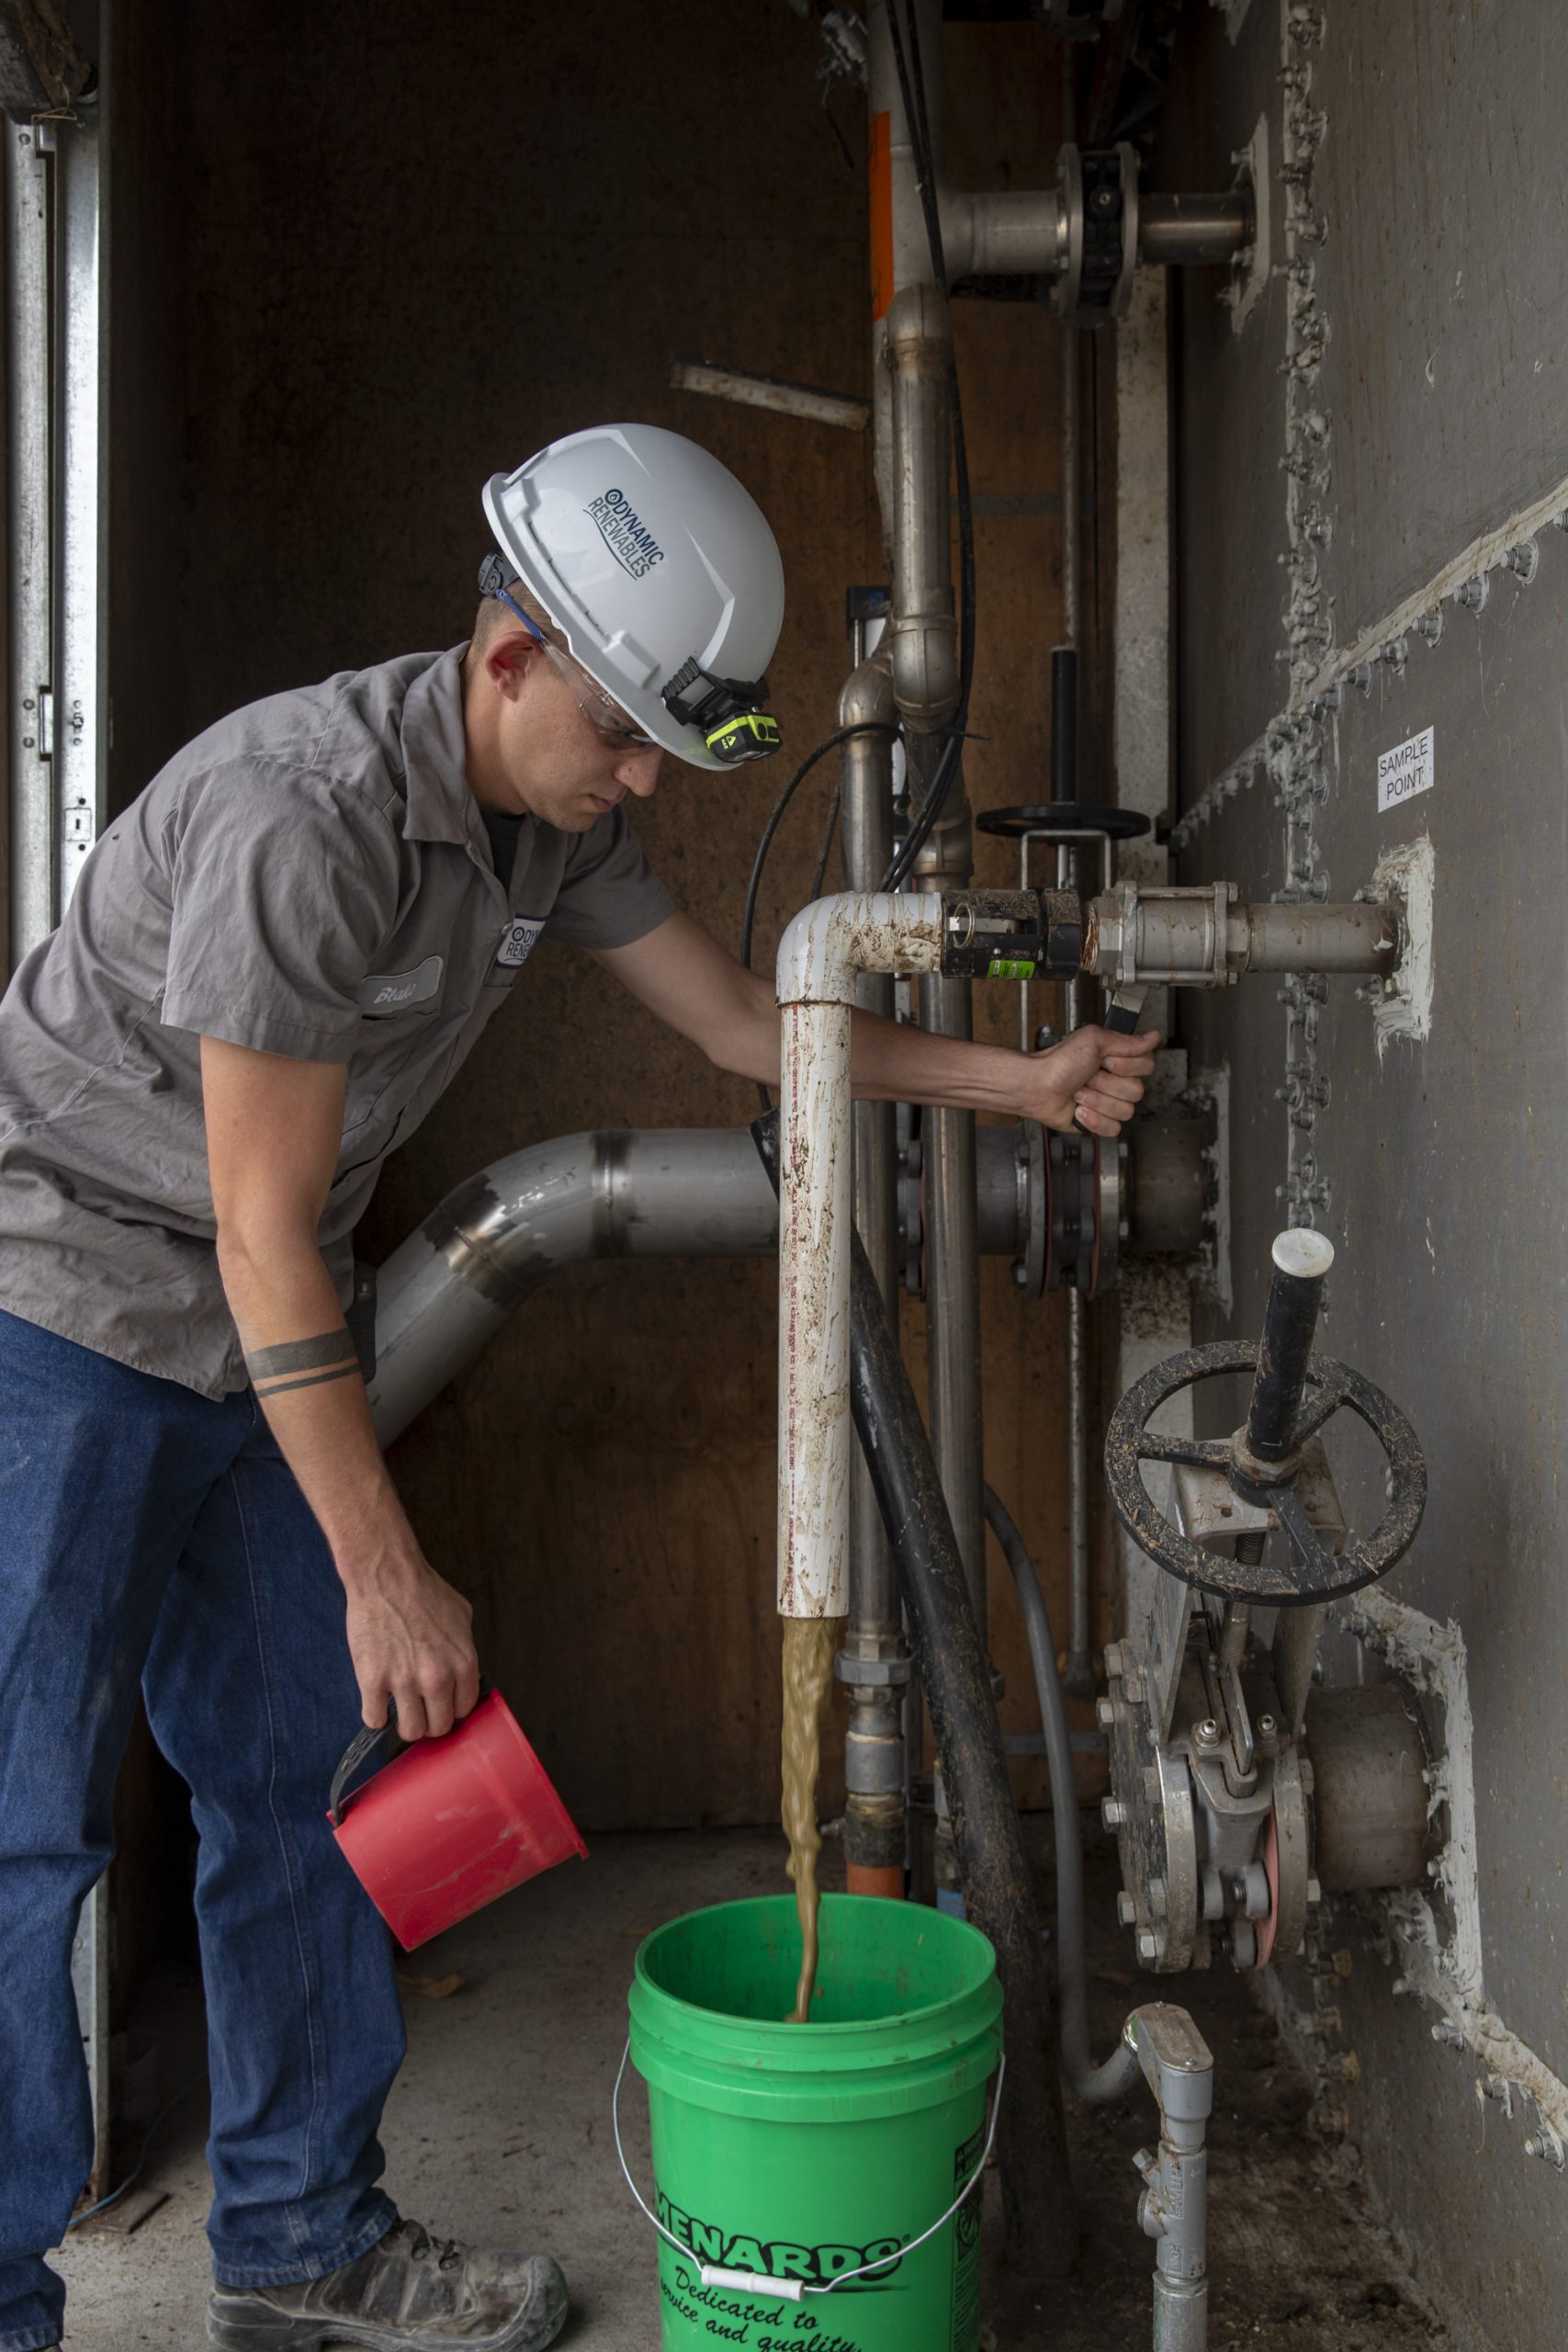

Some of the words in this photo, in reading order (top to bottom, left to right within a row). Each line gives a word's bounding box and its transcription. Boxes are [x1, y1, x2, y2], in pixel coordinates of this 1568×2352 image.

[588, 497, 650, 578] RENEWABLES
[613, 501, 664, 566] DYNAMIC
[1380, 736, 1428, 778] SAMPLE
[1387, 765, 1424, 800] POINT
[676, 2266, 784, 2326] Dedicated
[794, 2312, 819, 2330] to
[705, 2319, 749, 2344] and
